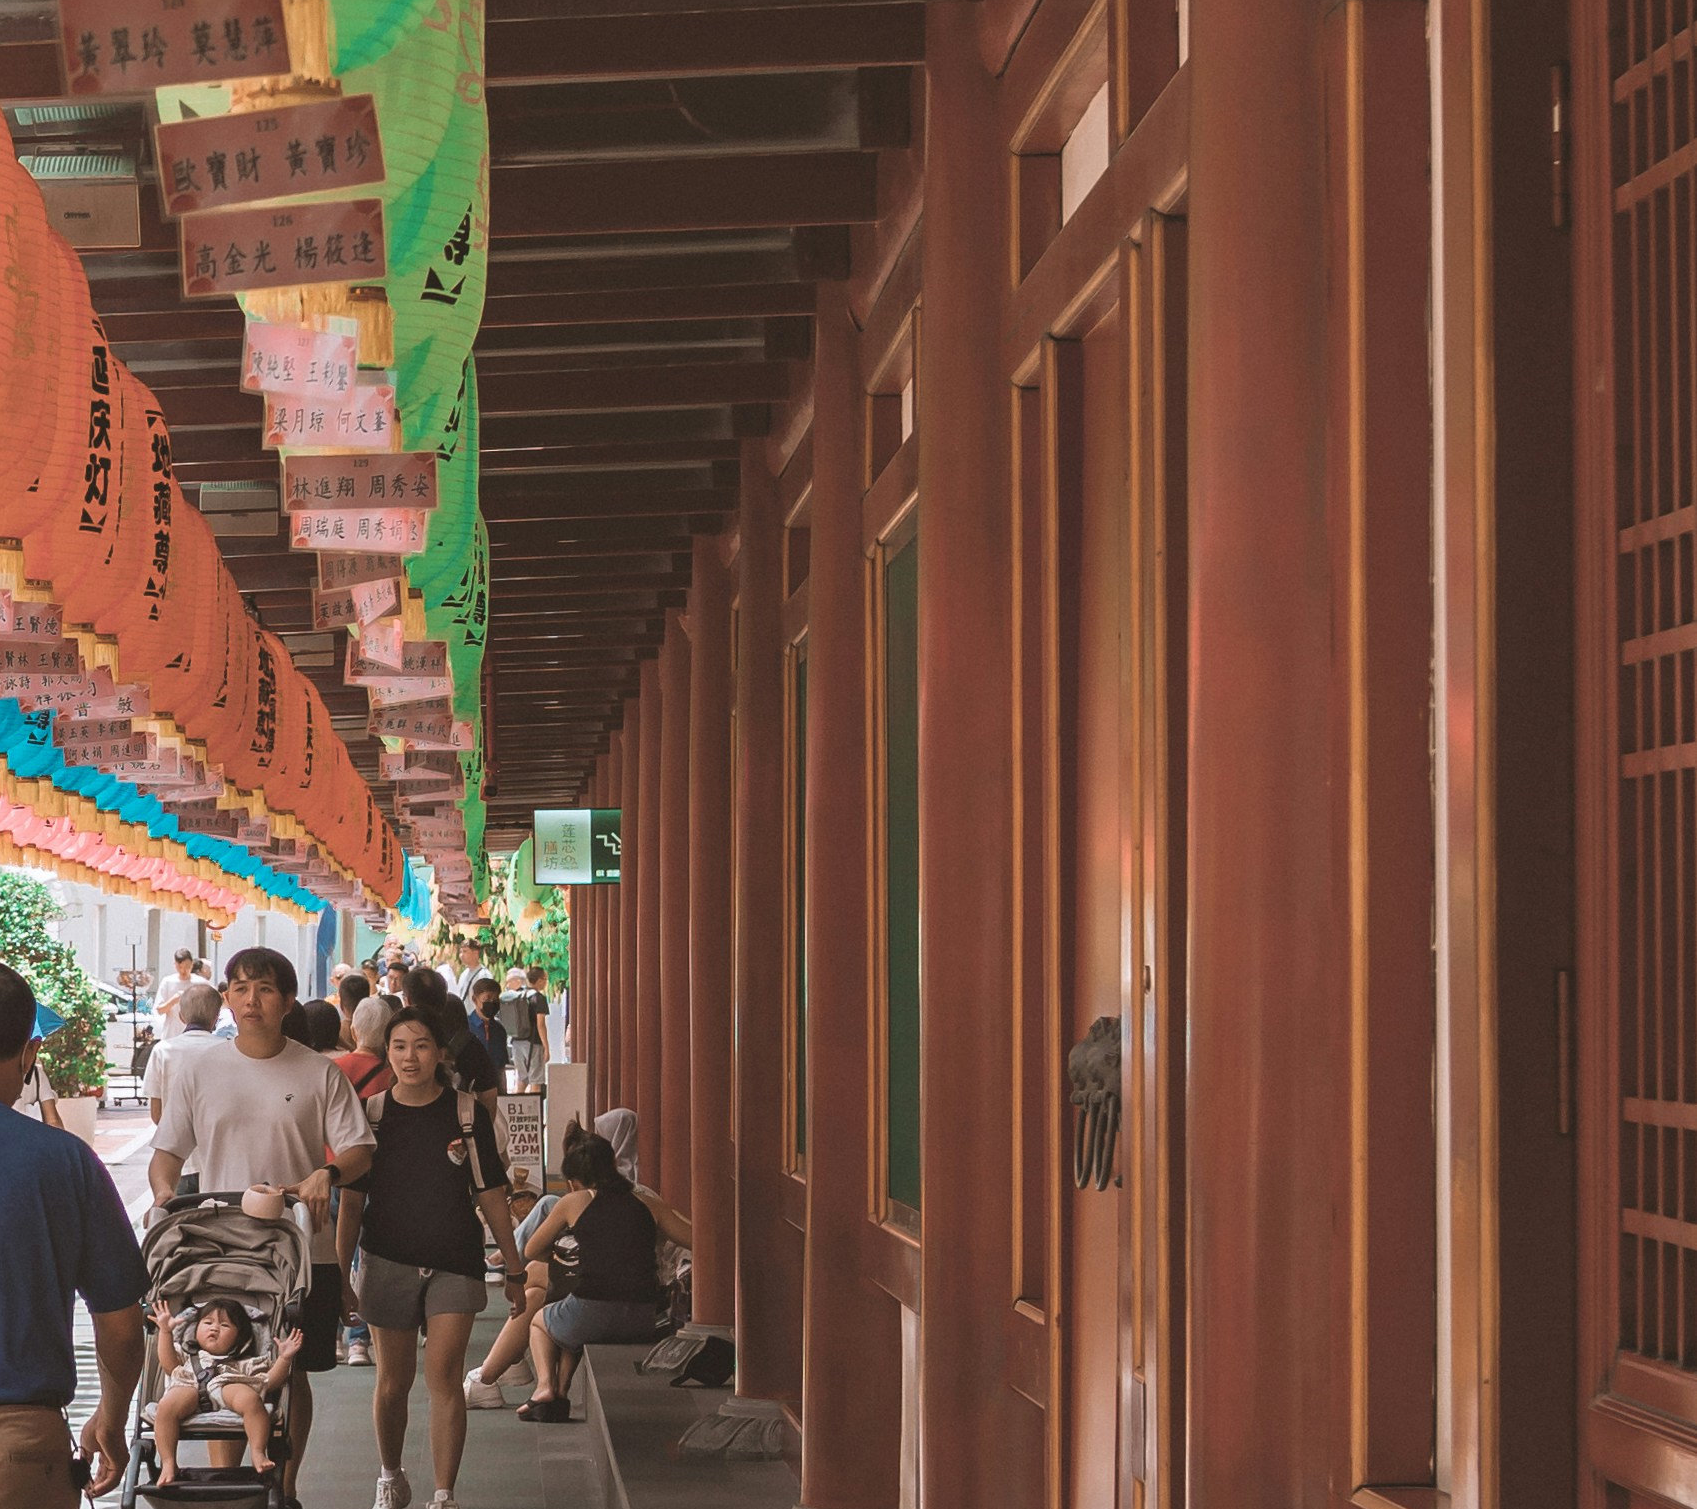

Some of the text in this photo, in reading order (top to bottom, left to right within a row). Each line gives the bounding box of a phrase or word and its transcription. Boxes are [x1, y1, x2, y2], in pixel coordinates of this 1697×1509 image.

[195, 240, 277, 280] 高金光
[353, 458, 370, 468] 129
[368, 472, 430, 499] 周秀姿
[509, 1124, 539, 1133] OPEN
[509, 1133, 539, 1145] 7AM
